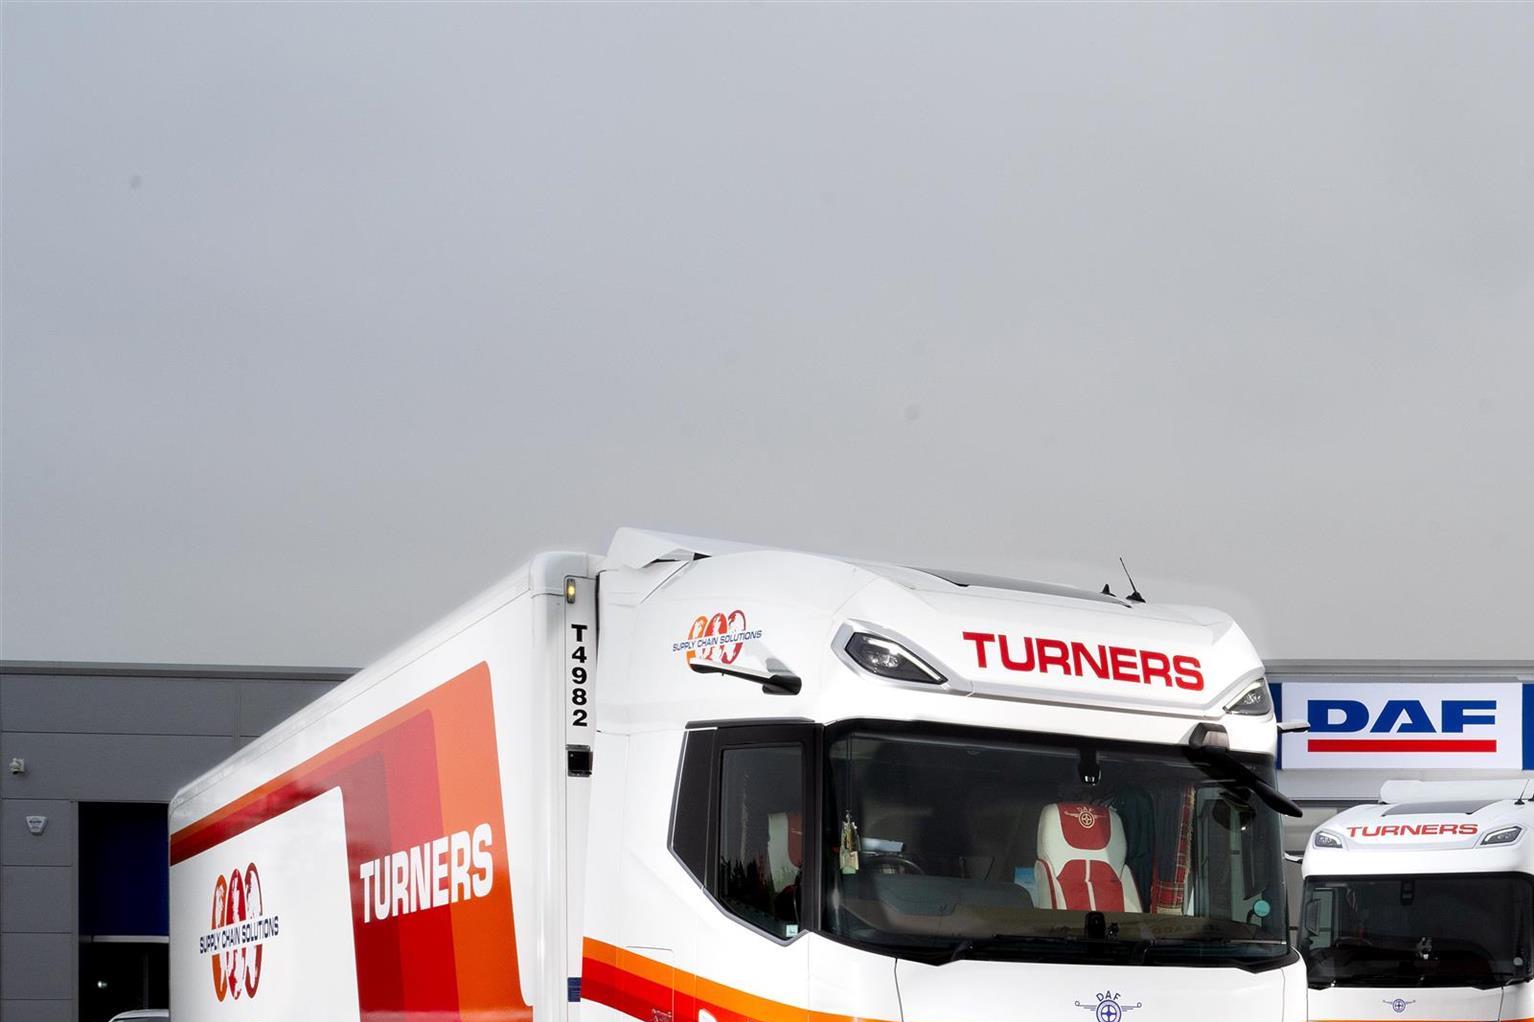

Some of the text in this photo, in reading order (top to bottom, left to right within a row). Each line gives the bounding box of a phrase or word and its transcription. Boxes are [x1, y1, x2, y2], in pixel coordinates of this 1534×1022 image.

[672, 629, 763, 652] SUPPLY CHAIN SOLUTIONS
[571, 623, 588, 728] T4982
[962, 631, 1206, 692] TURNERS
[1307, 699, 1498, 734] DAF
[1346, 823, 1479, 837] TURNERS
[359, 822, 494, 923] TURNERS
[199, 915, 279, 954] SUPPLY CHAIN SOLUTIONS
[1095, 990, 1121, 1001] DAF
